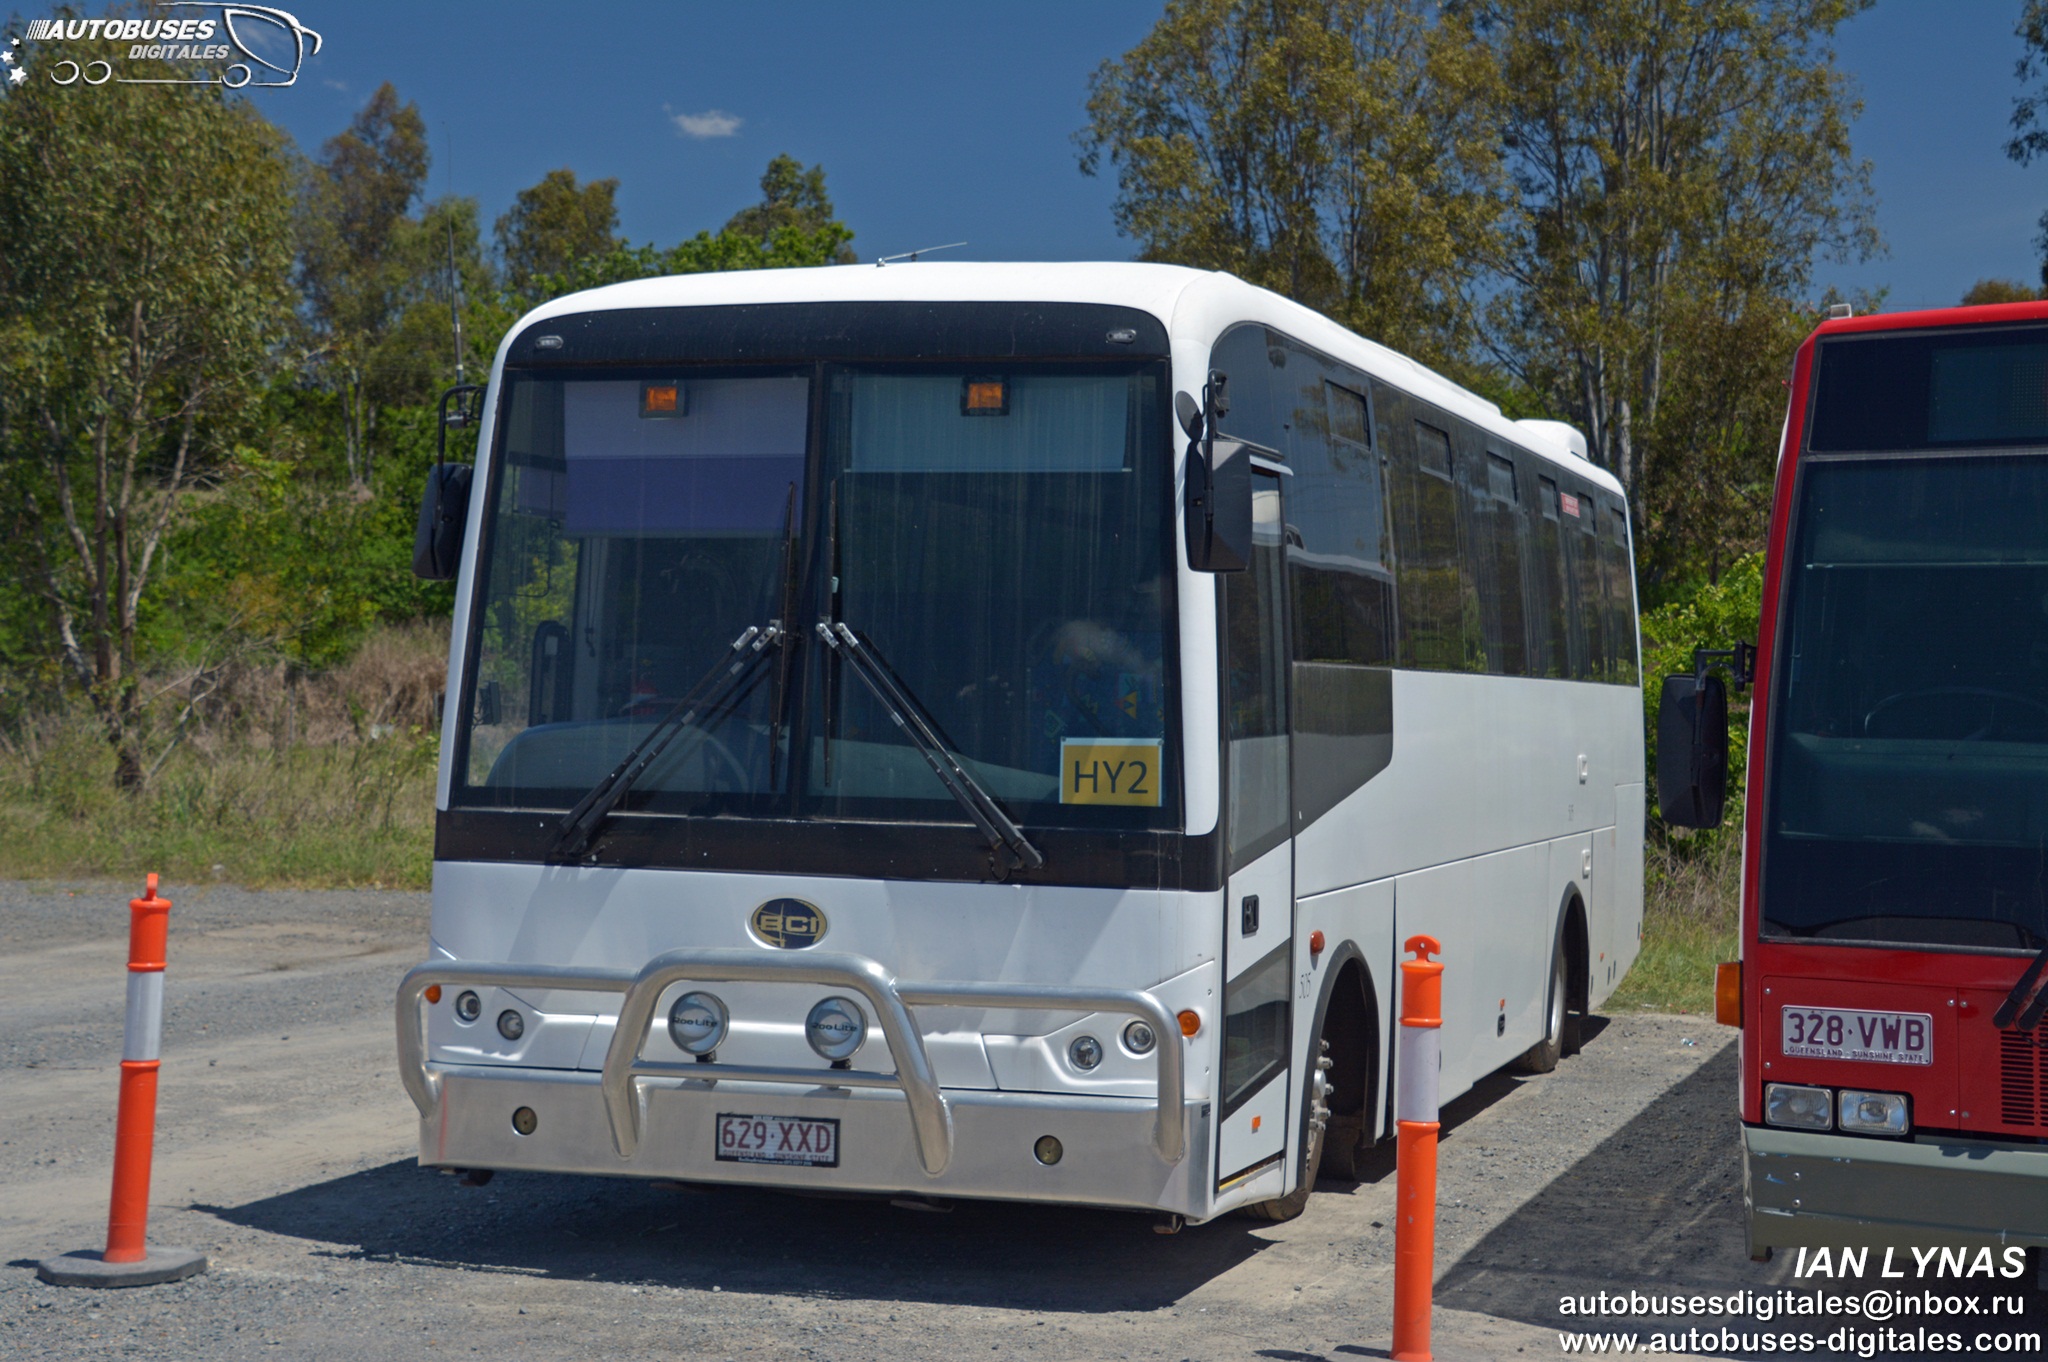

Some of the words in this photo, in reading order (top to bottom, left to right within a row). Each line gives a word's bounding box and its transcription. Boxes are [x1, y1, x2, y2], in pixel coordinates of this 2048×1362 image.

[1074, 760, 1149, 794] HY2
[760, 914, 817, 933] BCI
[1789, 1046, 1843, 1057] QUEENSLAND
[1852, 1050, 1893, 1060] SUNSHINE
[1898, 1053, 1924, 1062] STATE
